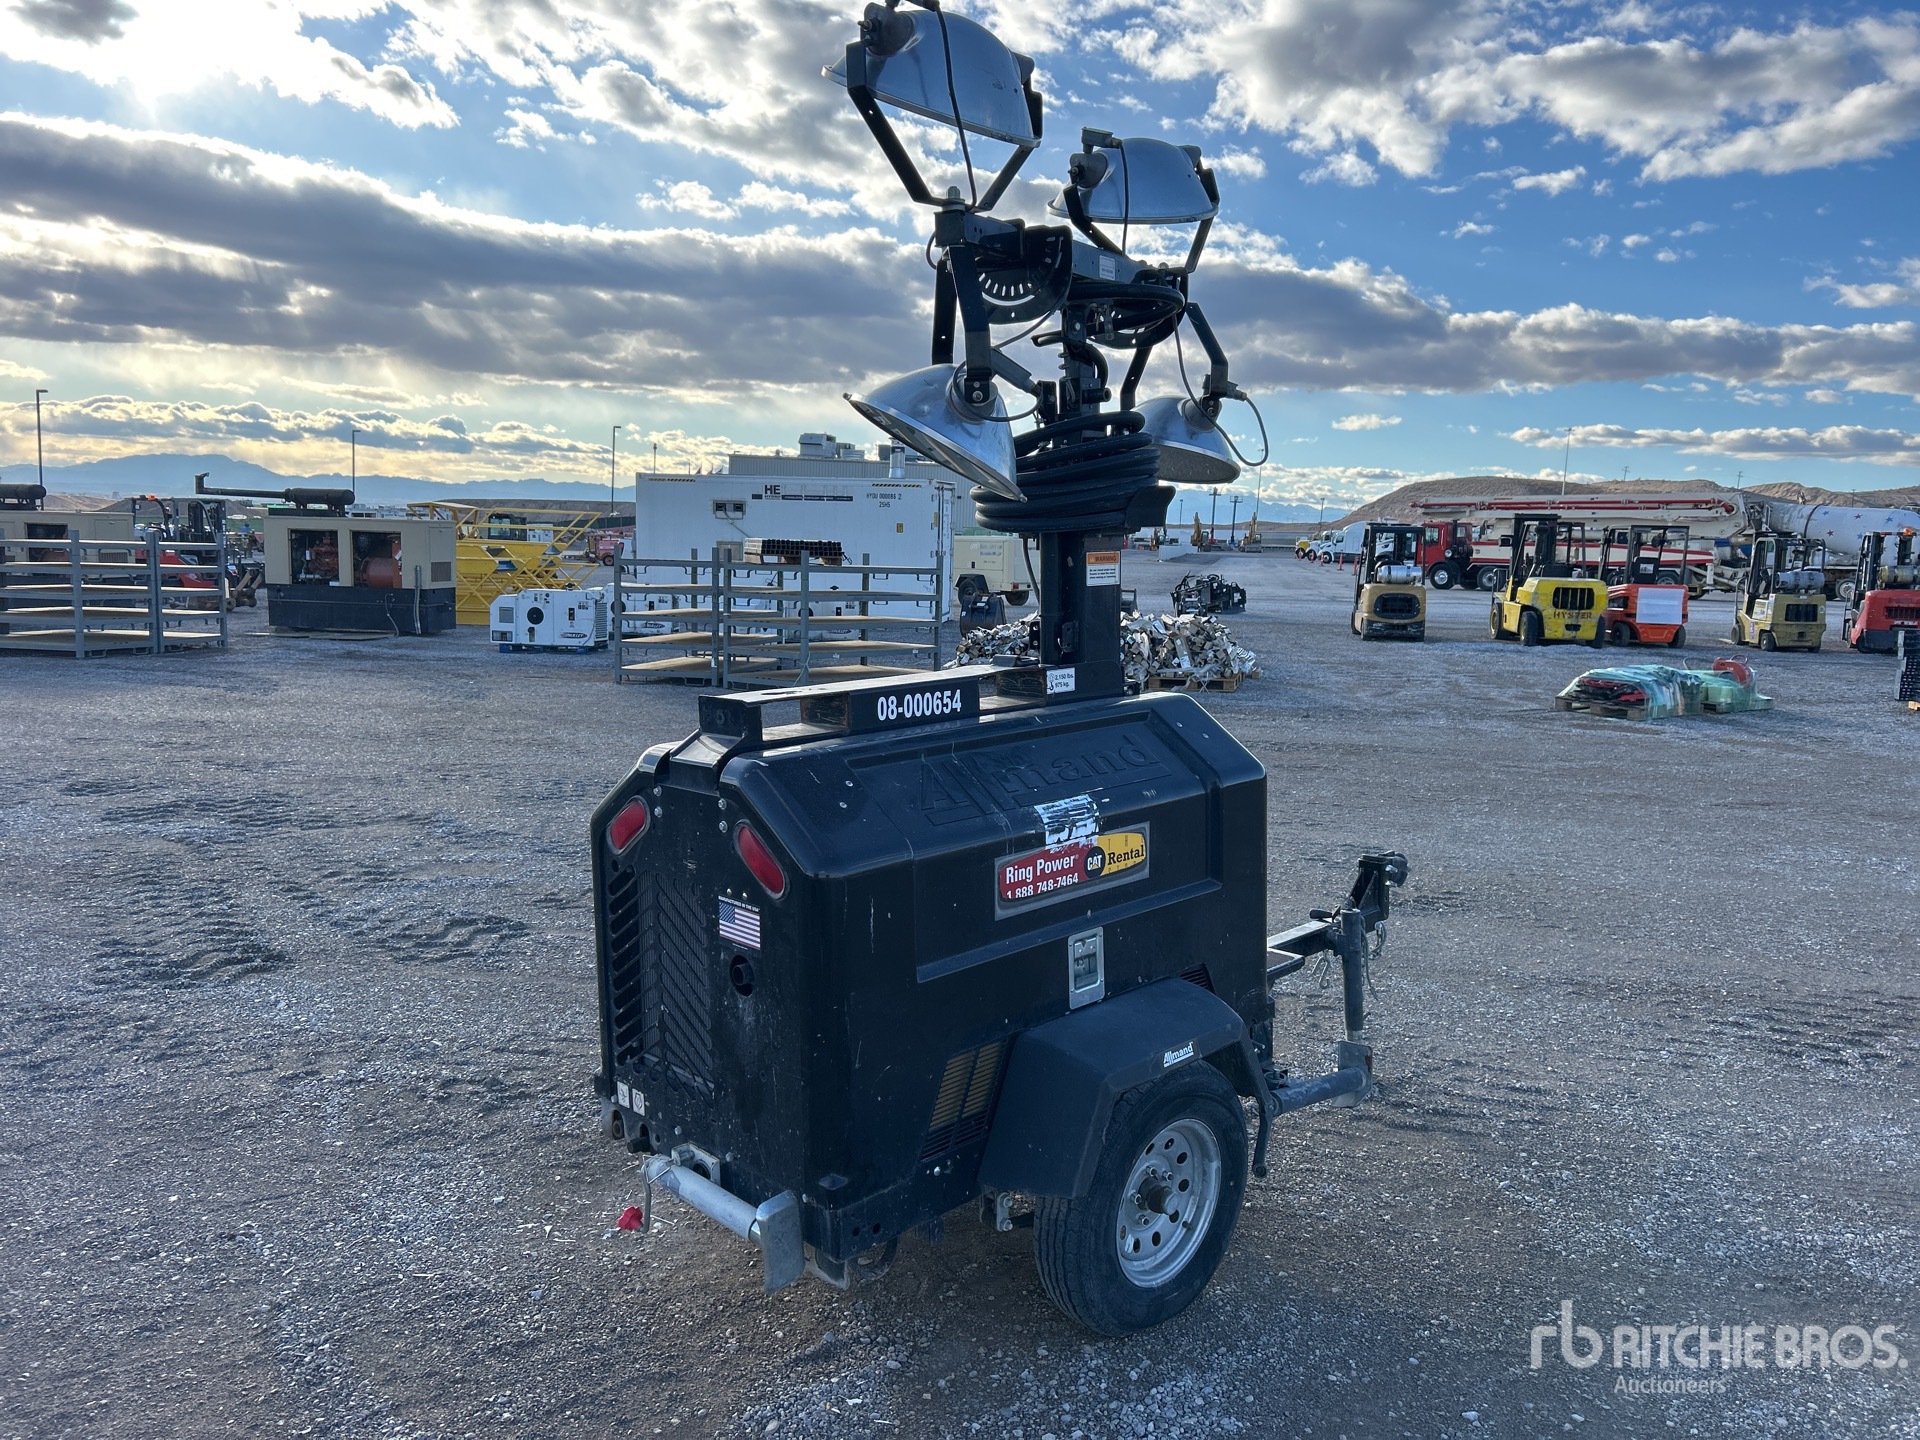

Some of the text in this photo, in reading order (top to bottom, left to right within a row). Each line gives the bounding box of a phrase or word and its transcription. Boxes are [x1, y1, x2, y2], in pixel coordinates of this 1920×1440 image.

[877, 688, 962, 721] 08-000654
[920, 734, 1161, 815] Allmand
[1087, 854, 1102, 871] CAT
[1107, 844, 1145, 866] Rental
[1006, 865, 1033, 885] Ring
[1006, 872, 1078, 900] 1 888 748-7464
[1163, 1041, 1194, 1065] Allmand
